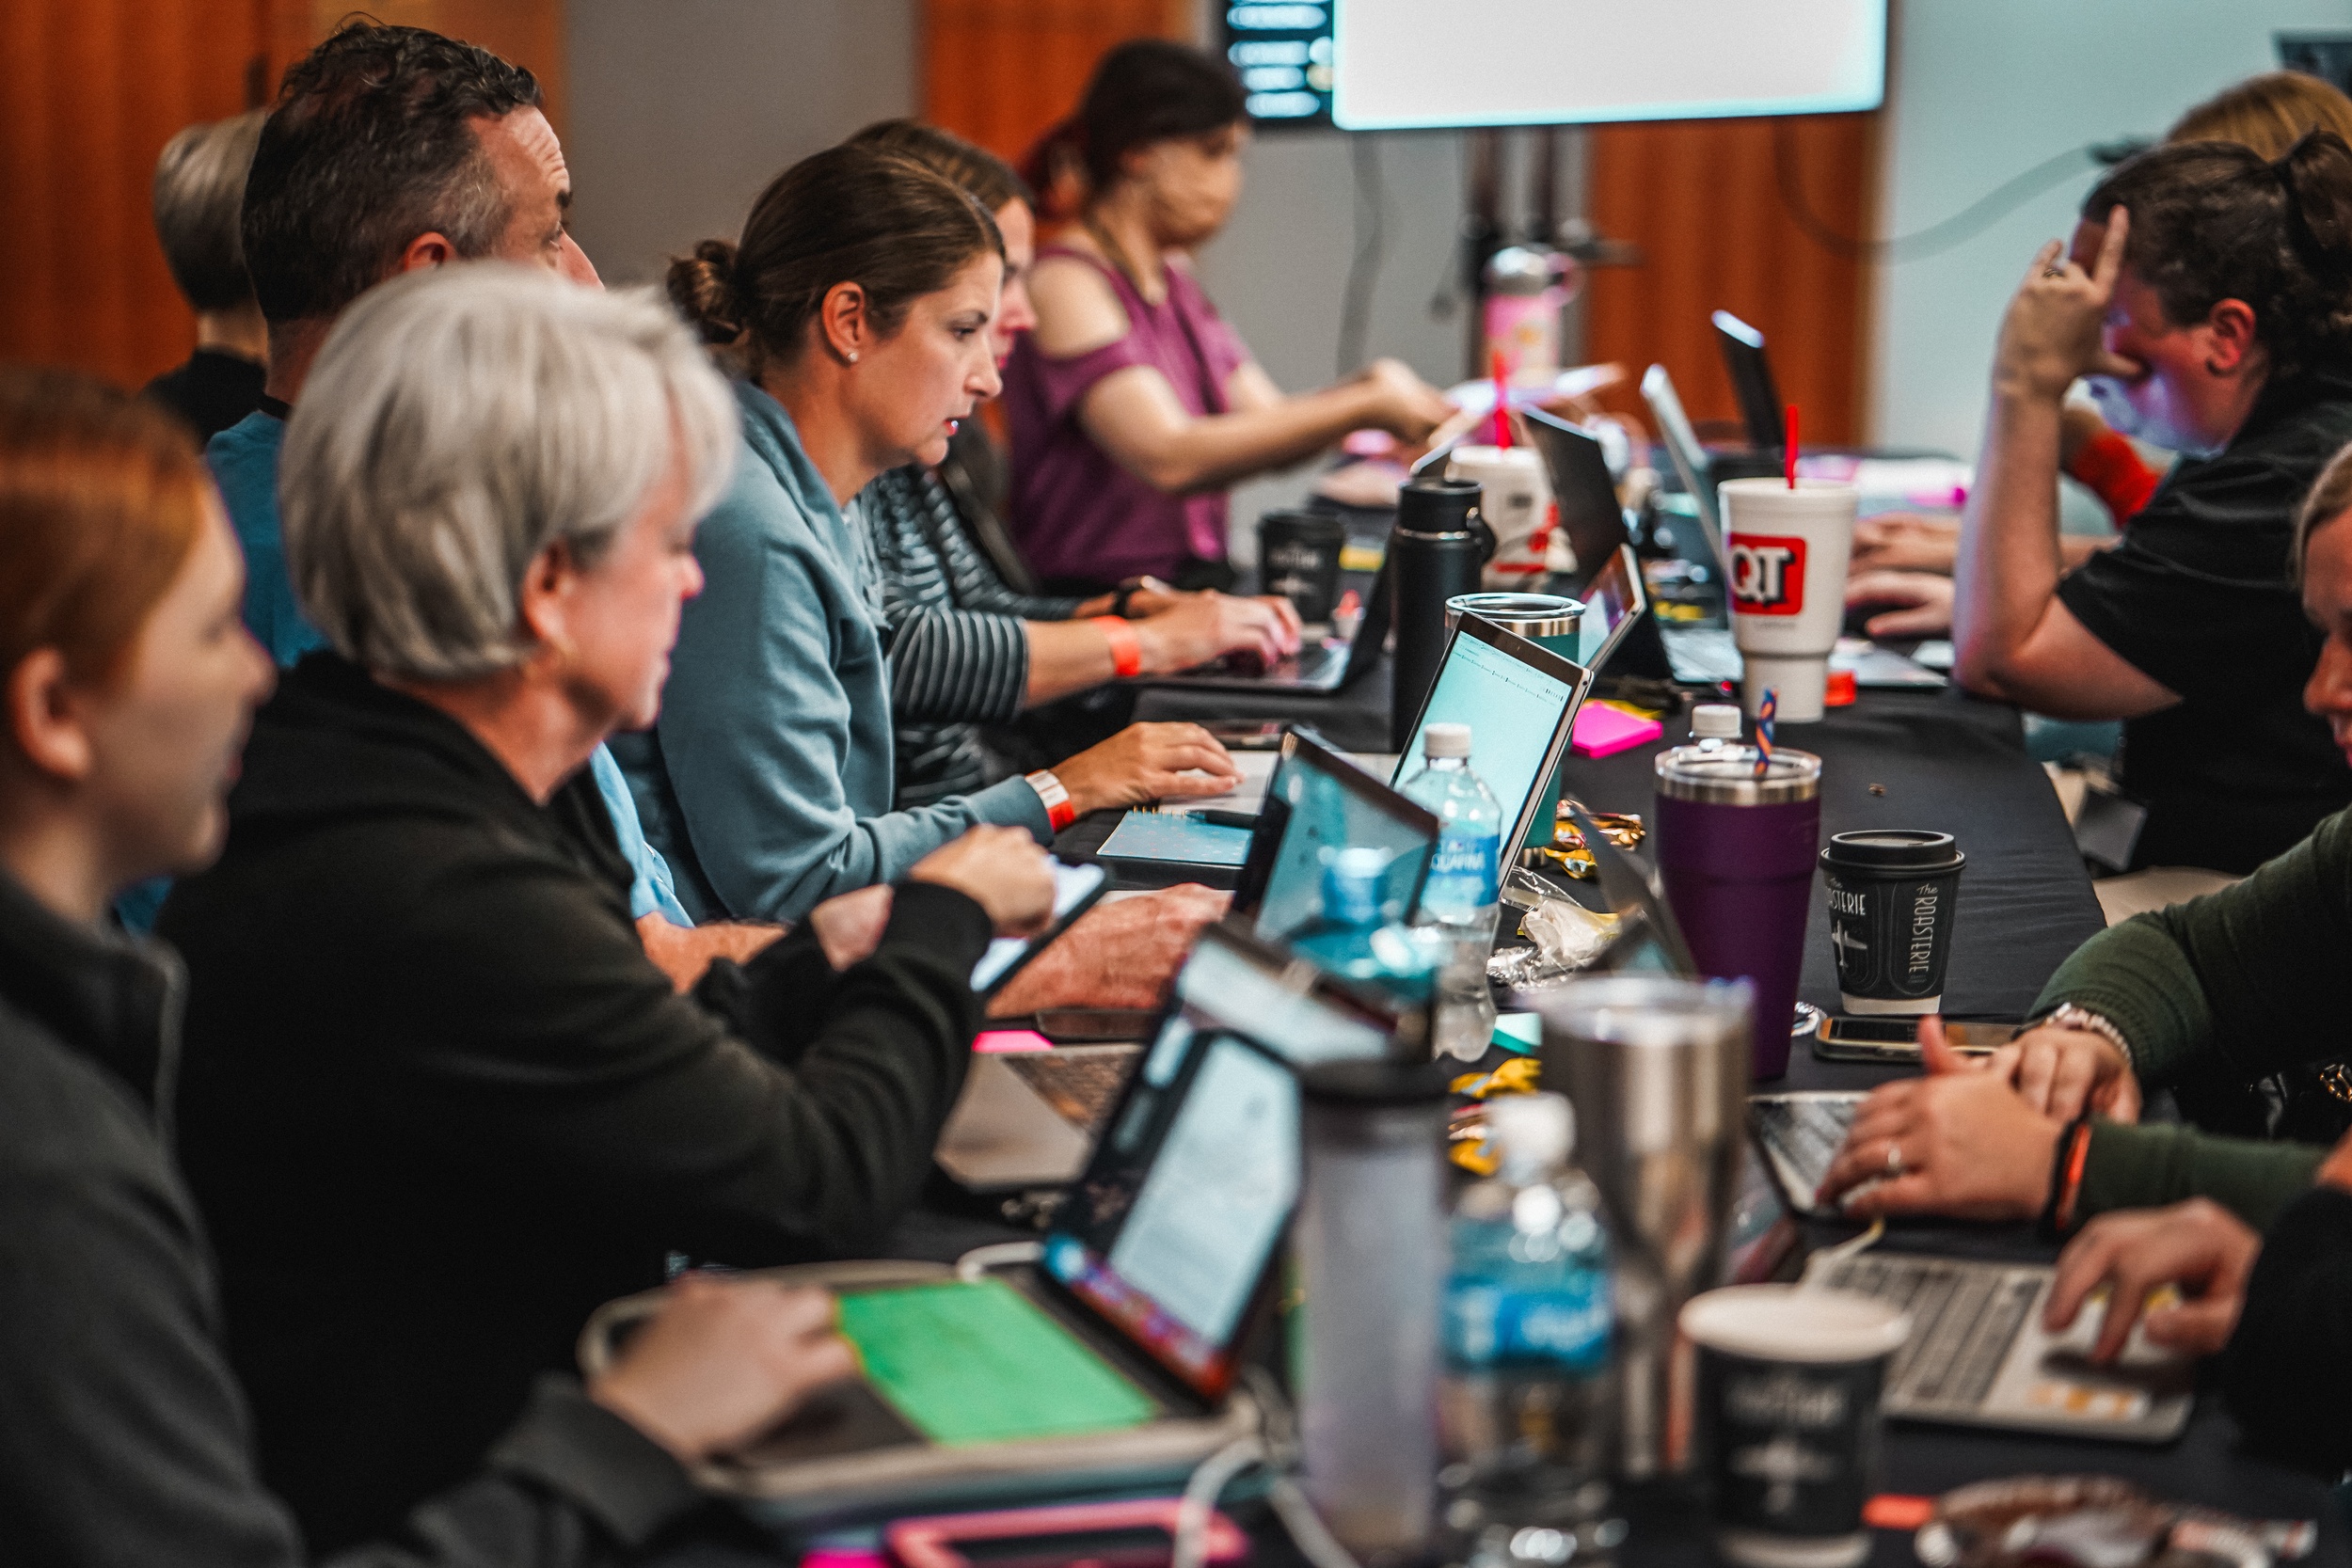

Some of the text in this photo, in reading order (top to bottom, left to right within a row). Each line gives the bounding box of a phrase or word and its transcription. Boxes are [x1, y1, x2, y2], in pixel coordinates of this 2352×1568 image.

[1729, 543, 1794, 606] QT
[1831, 889, 1866, 916] STERIE
[1916, 883, 1938, 895] The
[1908, 895, 1938, 974] ROASTERIE
